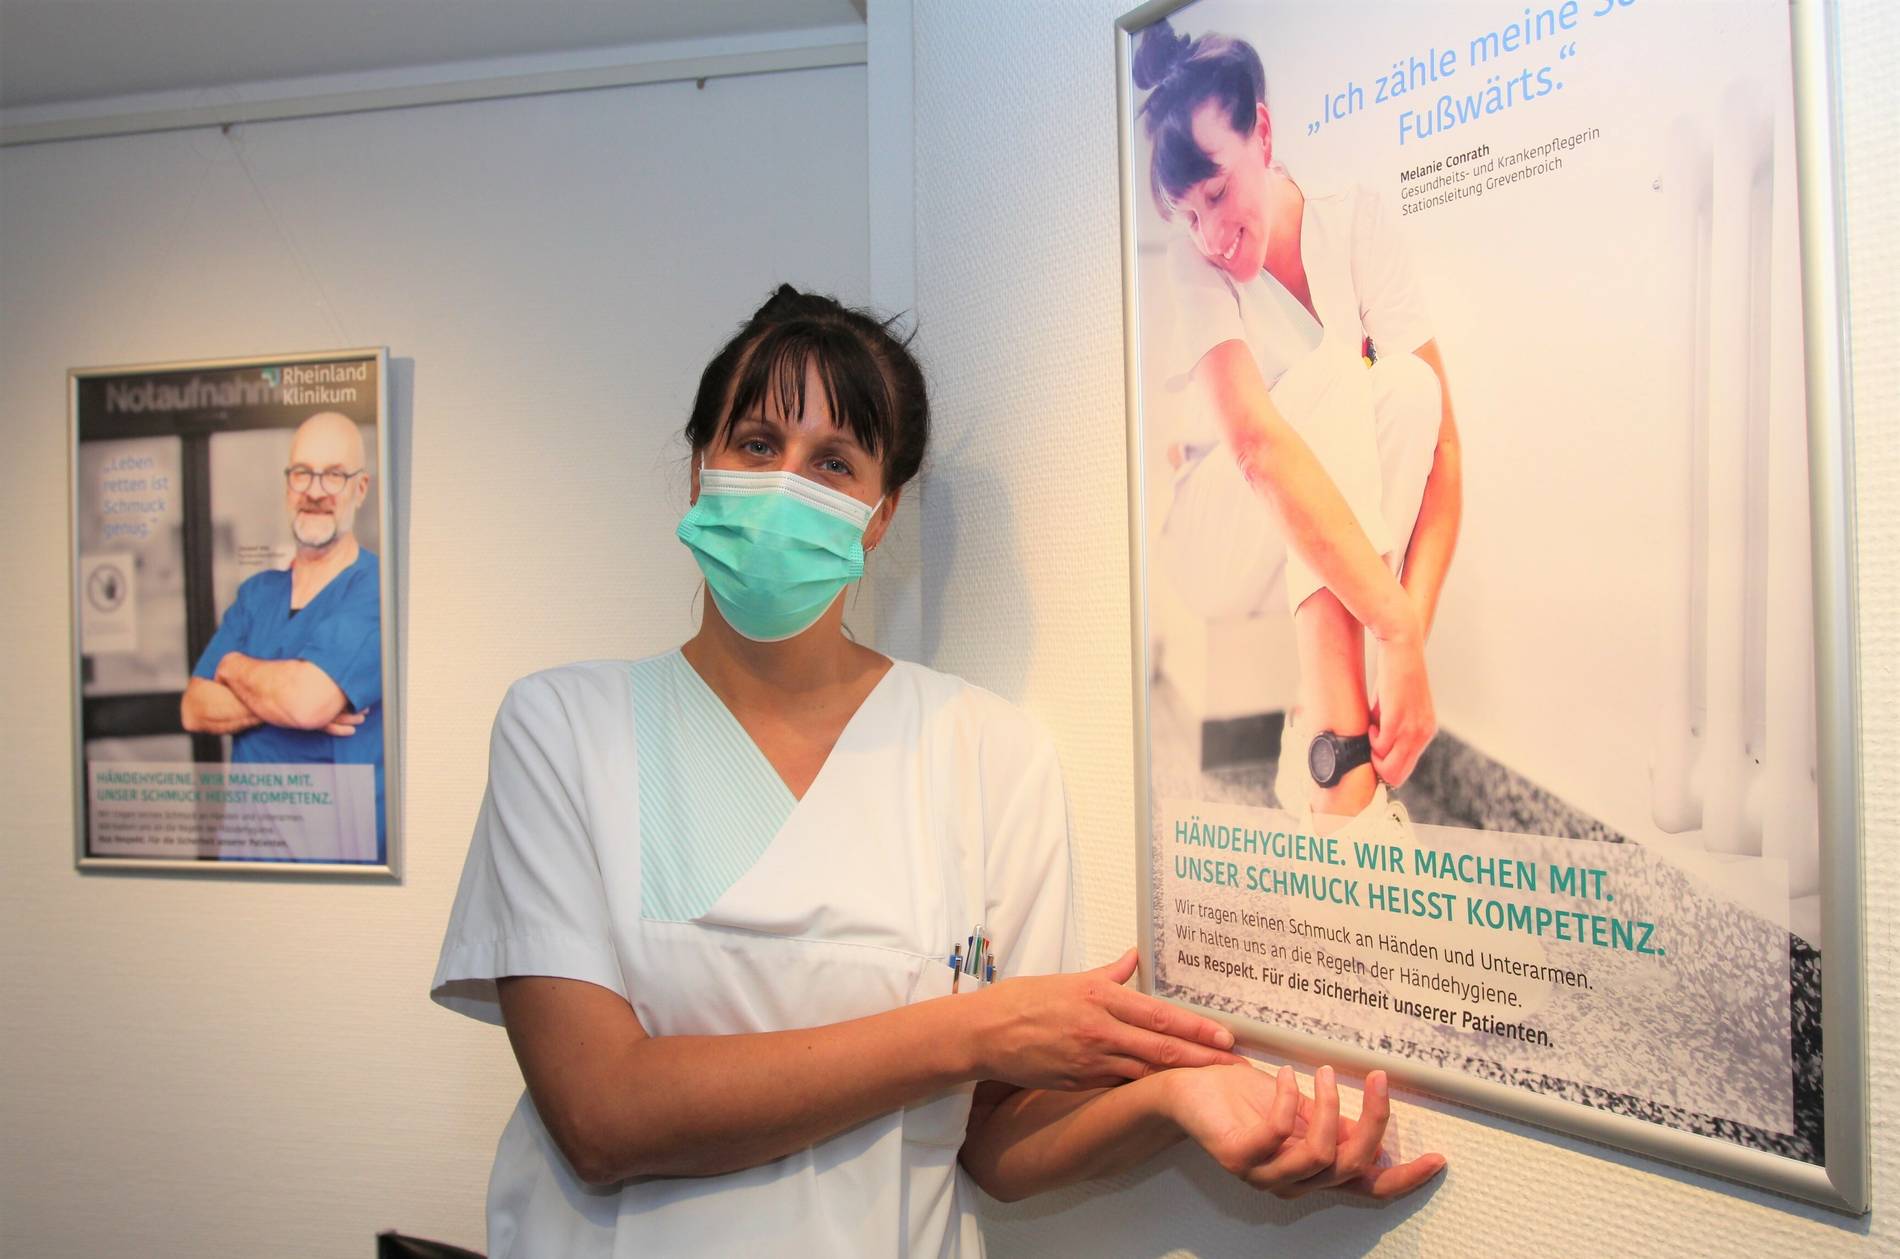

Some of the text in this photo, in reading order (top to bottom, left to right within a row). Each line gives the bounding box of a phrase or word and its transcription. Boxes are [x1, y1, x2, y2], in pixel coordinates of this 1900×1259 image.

[1307, 0, 1578, 136] „Ich zähle meine
[1400, 41, 1576, 145] Fußwärts.“
[1400, 144, 1490, 183] Melanie Conrath
[1401, 127, 1600, 199] Gesundheits- und Krankenpflegerin
[1402, 156, 1563, 216] Stationsleitung Grevenbroich
[283, 363, 367, 384] Rheinland
[283, 386, 357, 406] Klinikum
[151, 475, 169, 493] ist
[96, 788, 137, 801] UNSER
[141, 788, 200, 802] SCHMUCK
[251, 791, 334, 806] KOMPETENZ.
[228, 773, 283, 787] MACHEN
[287, 774, 314, 787] MIT.
[1175, 816, 1614, 903] HÄNDEHYGIENE. WIR MACHEN MIT.
[1175, 855, 1666, 957] UNSER SCHMUCK HEISST KOMPETENZ.
[1175, 898, 1594, 990] Wir tragen keinen Schmuck an Händen und Unterarmen.
[1175, 924, 1522, 1008] Wir halten uns an die Regeln der Händehygiene.
[1178, 950, 1554, 1048] Aus Respekt. Für die Sicherheit unserer Patienten.
